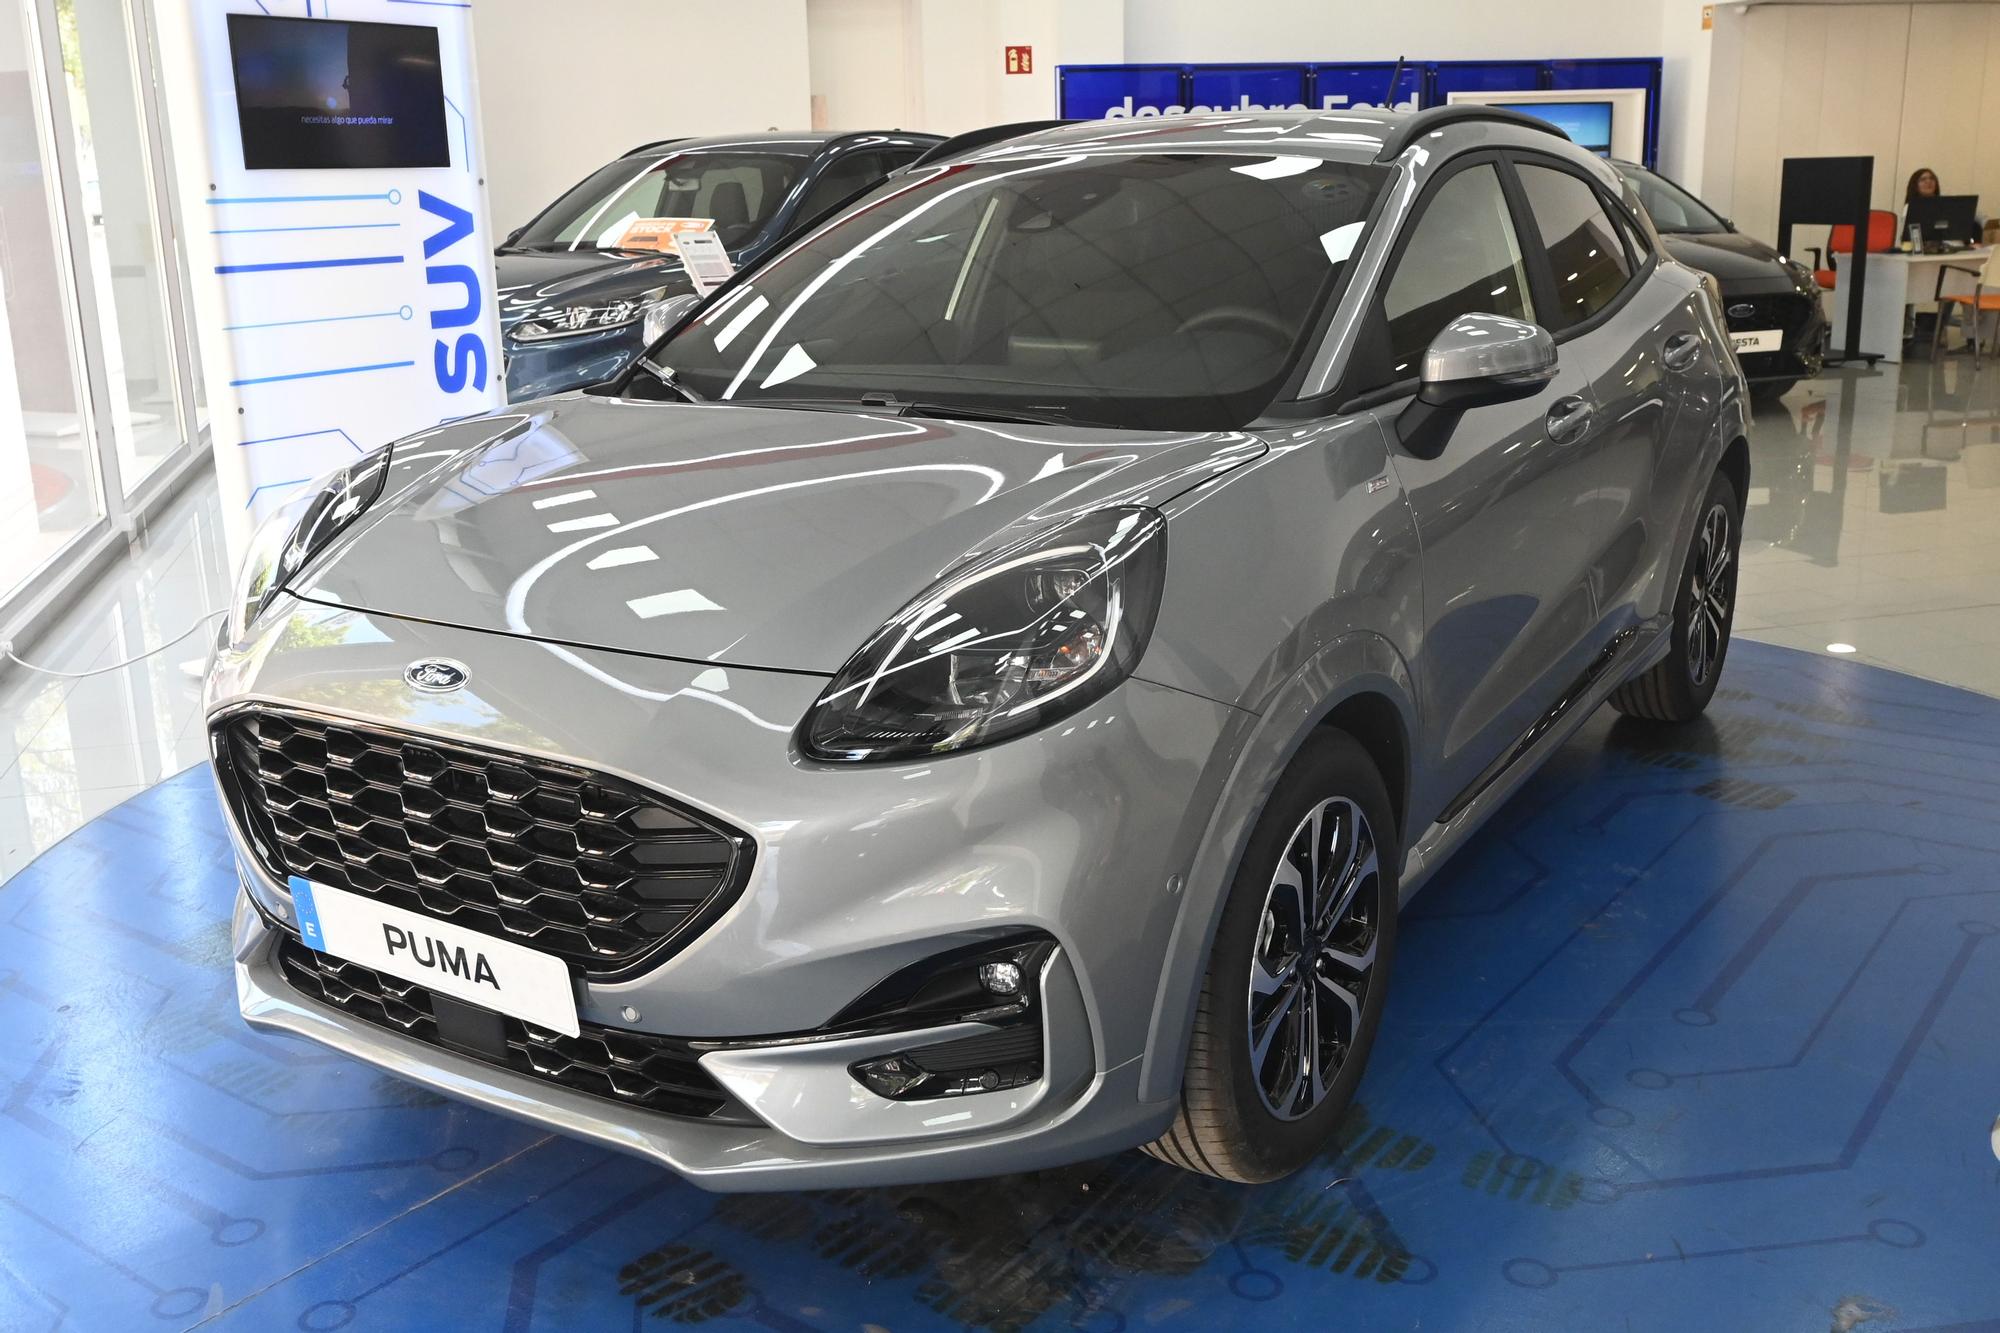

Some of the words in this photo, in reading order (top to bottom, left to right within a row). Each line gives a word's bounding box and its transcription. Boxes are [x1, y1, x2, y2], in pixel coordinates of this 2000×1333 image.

[331, 115, 344, 125] algo
[345, 117, 357, 125] que
[358, 116, 377, 125] pueda
[378, 116, 393, 124] mirar
[418, 189, 488, 394] SUV
[416, 664, 456, 685] Ford
[305, 922, 317, 938] E
[382, 923, 501, 991] PUMA
